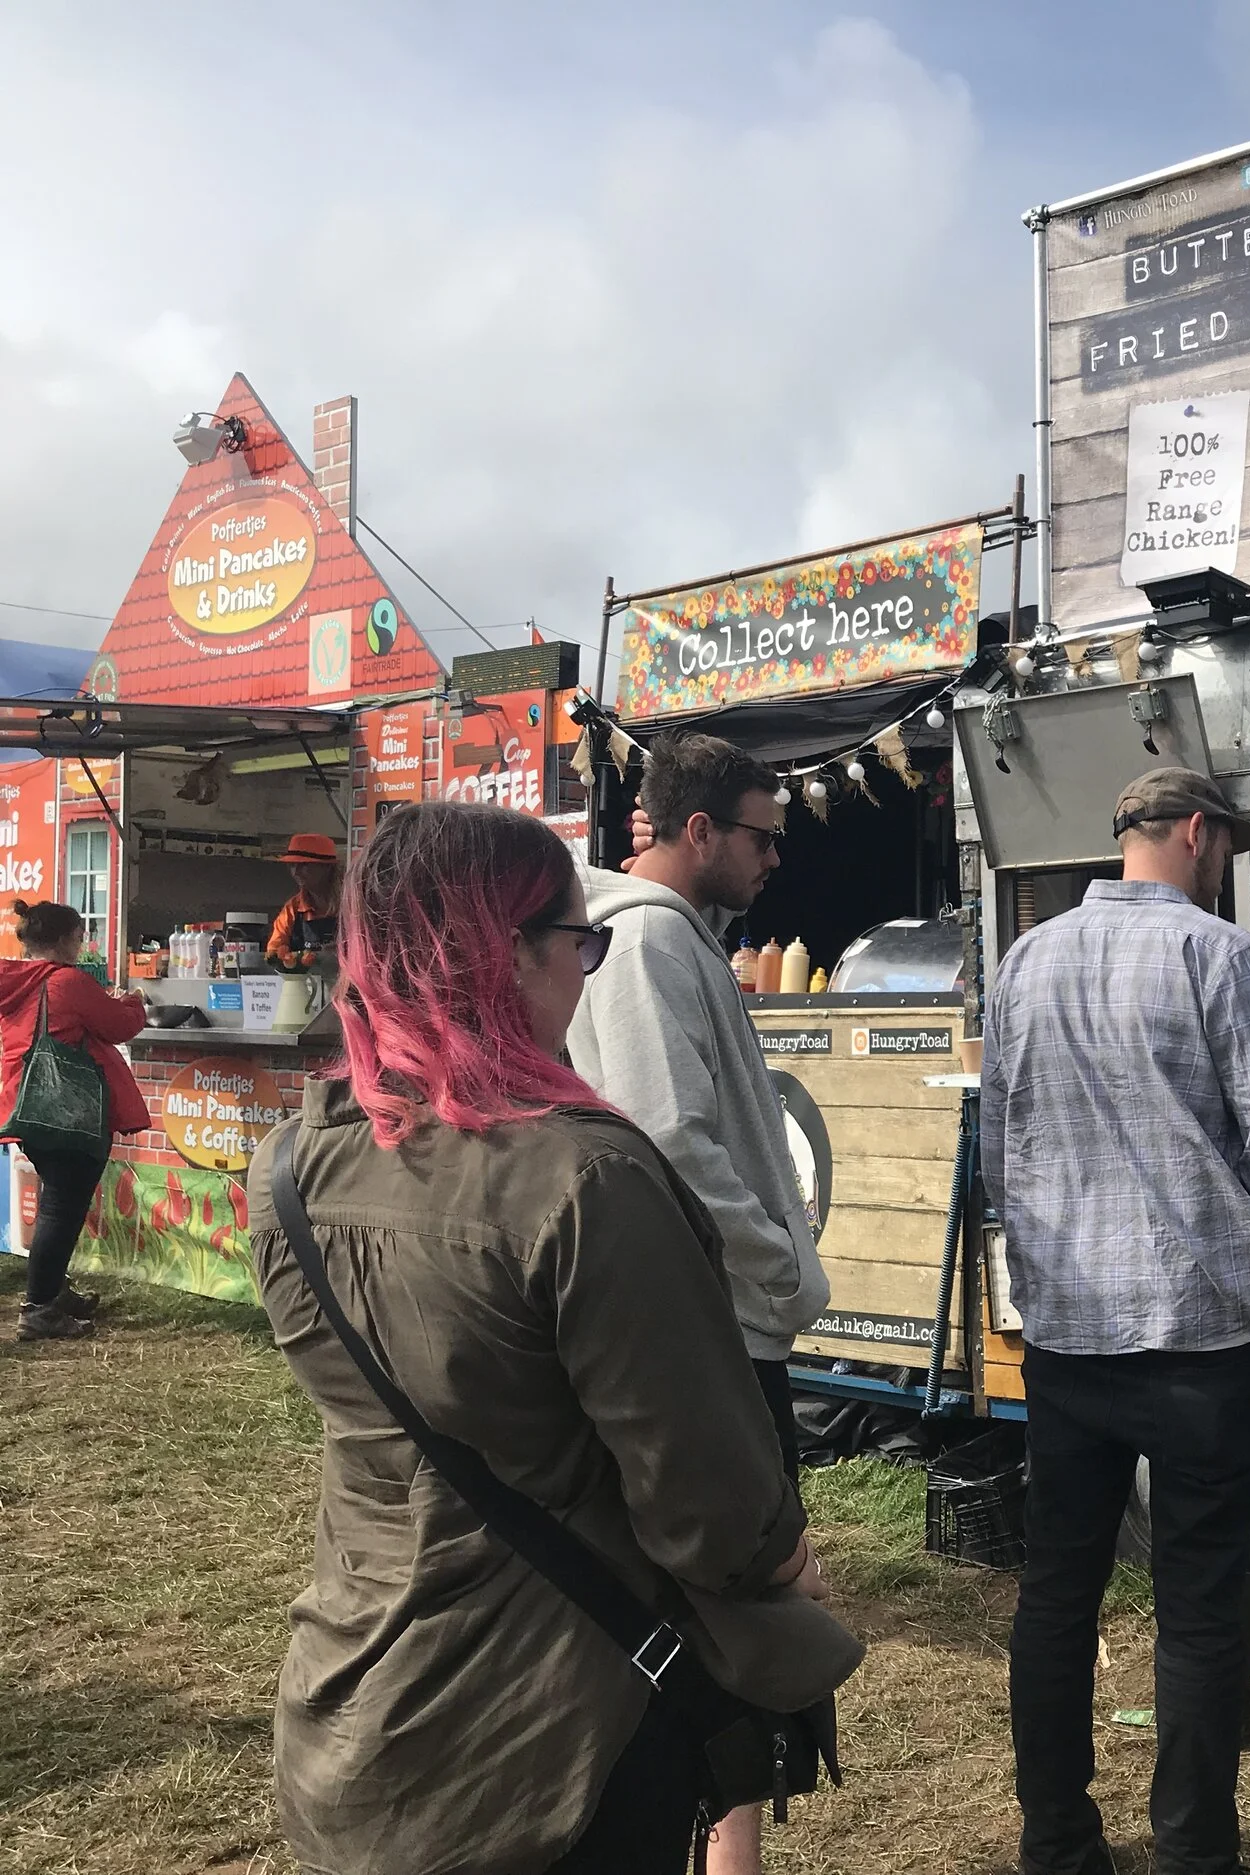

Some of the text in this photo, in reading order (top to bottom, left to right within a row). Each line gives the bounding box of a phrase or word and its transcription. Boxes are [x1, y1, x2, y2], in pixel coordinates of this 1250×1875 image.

[1091, 311, 1229, 372] FRIED
[1158, 433, 1220, 460] 100%
[1158, 465, 1216, 491] Free
[1147, 498, 1223, 523] Range
[212, 515, 266, 542] Poffertjes
[1127, 523, 1237, 553] Chicken!
[174, 536, 307, 587] Mini Pancakes
[197, 579, 276, 619] & Drinks
[678, 595, 913, 676] Collect here
[363, 659, 400, 674] FAIRTRADE
[382, 739, 407, 754] Mini
[503, 737, 532, 766] Cup
[370, 756, 419, 773] Pancakes
[373, 781, 415, 793] 10 Pancakes
[871, 1032, 950, 1052] HungryToad
[193, 1068, 255, 1095] Poffertjes
[167, 1093, 286, 1127] Mini Pancakes
[184, 1124, 259, 1155] & Coffee
[811, 1316, 936, 1341] oad.uk@gmail.co
